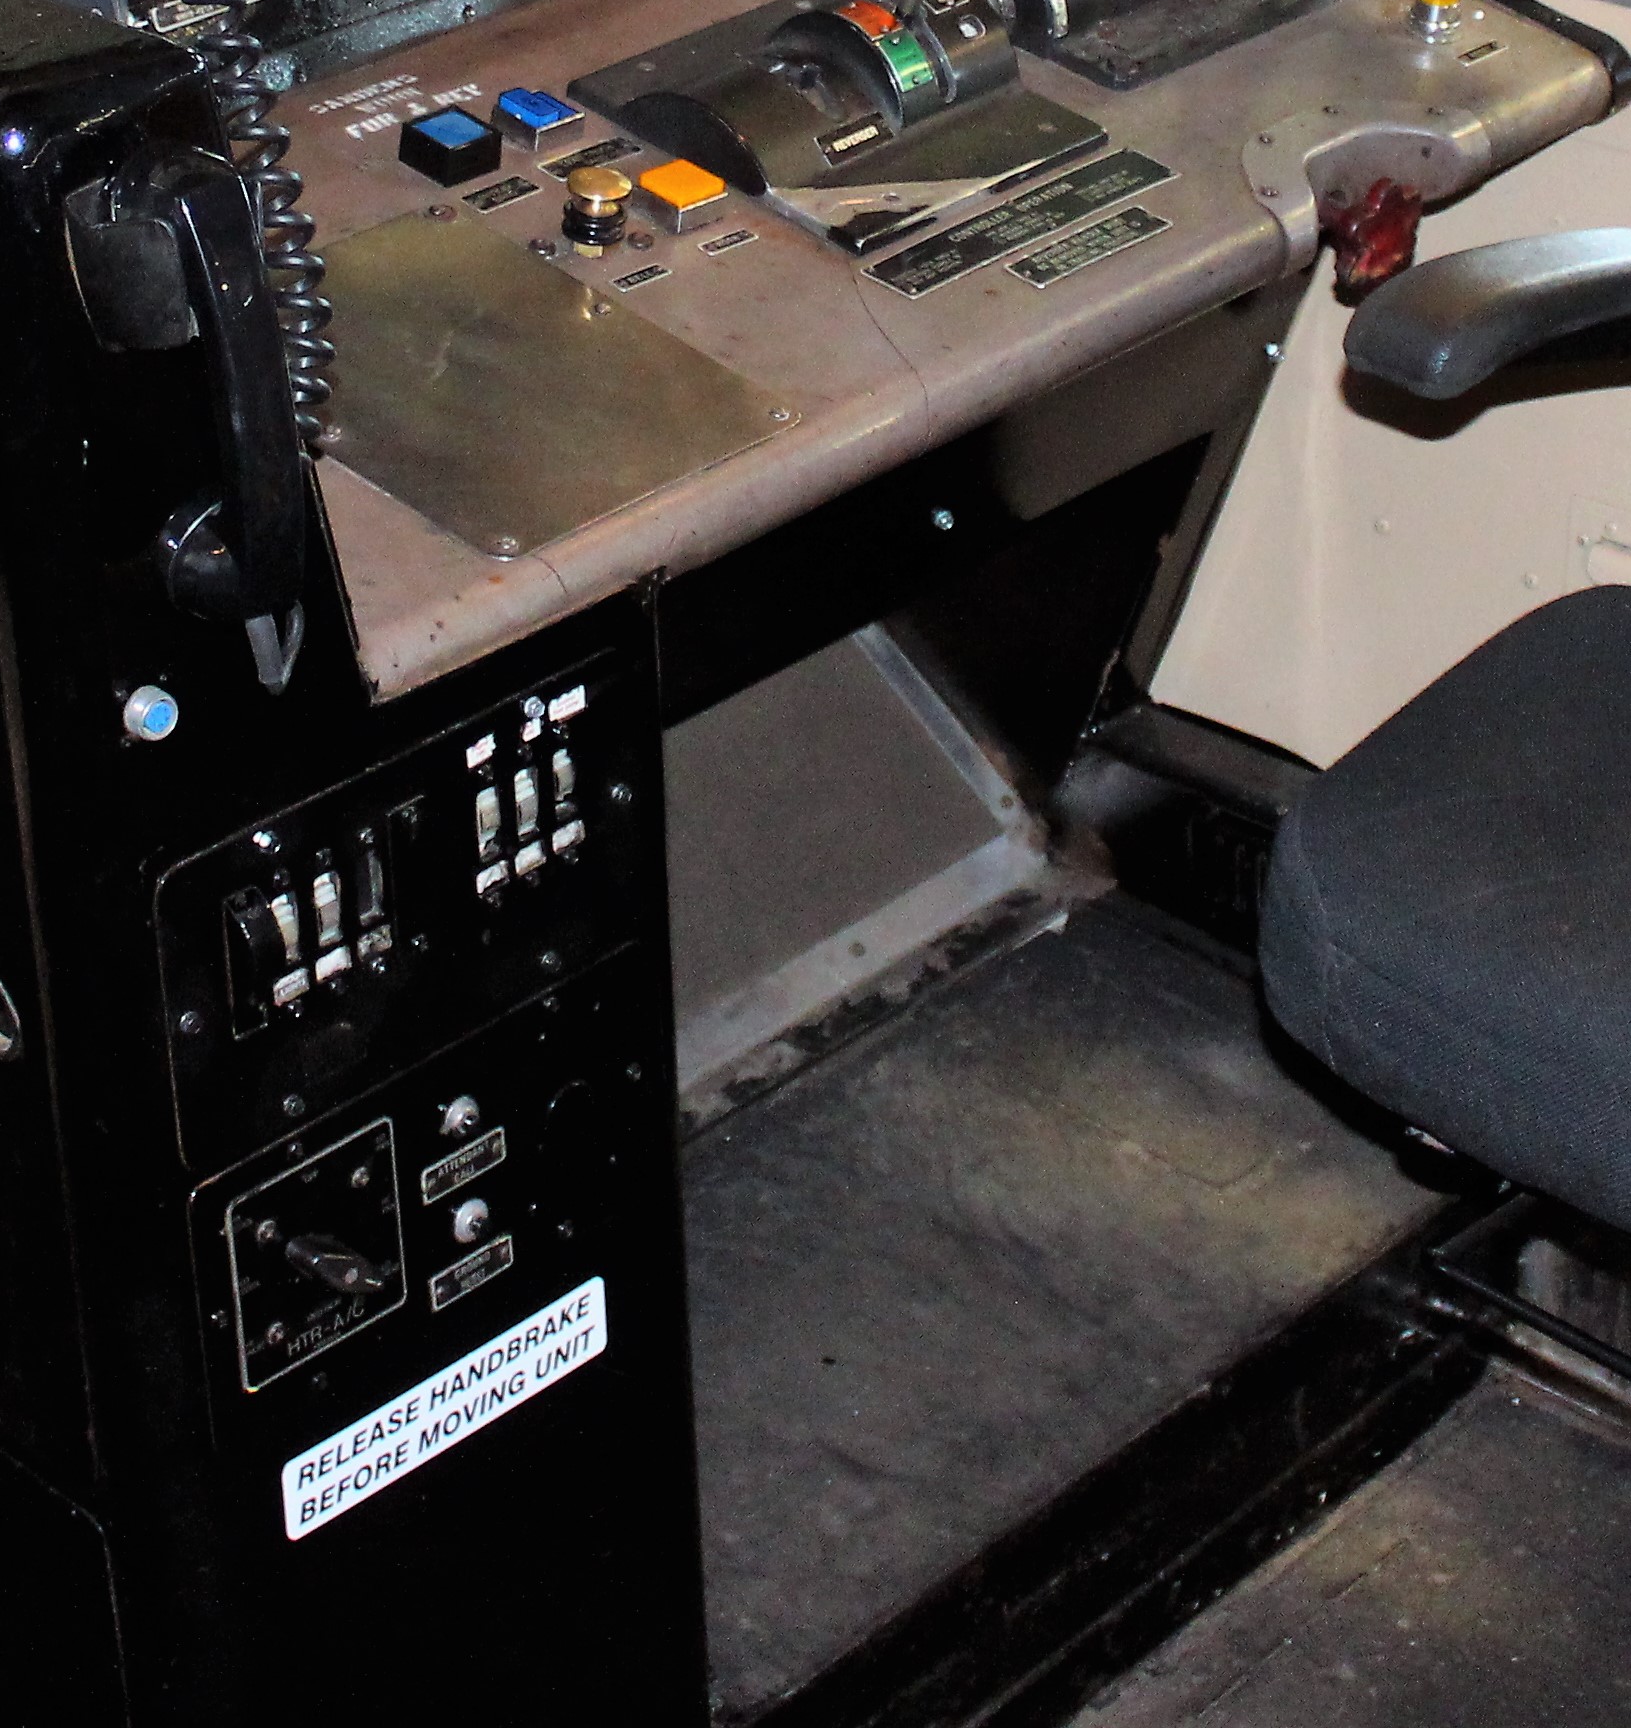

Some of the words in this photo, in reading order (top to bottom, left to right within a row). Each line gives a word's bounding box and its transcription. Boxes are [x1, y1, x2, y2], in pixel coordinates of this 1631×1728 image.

[831, 125, 880, 153] REVERSER
[948, 210, 1014, 243] CONTROLLER
[437, 1139, 491, 1179] ATTENDANT
[296, 1397, 422, 1491] RELEASE
[428, 1292, 593, 1411] HANDBRAKE
[299, 1440, 411, 1525] BEFORE
[418, 1370, 527, 1454] MOVING
[535, 1324, 596, 1381] UNIT
